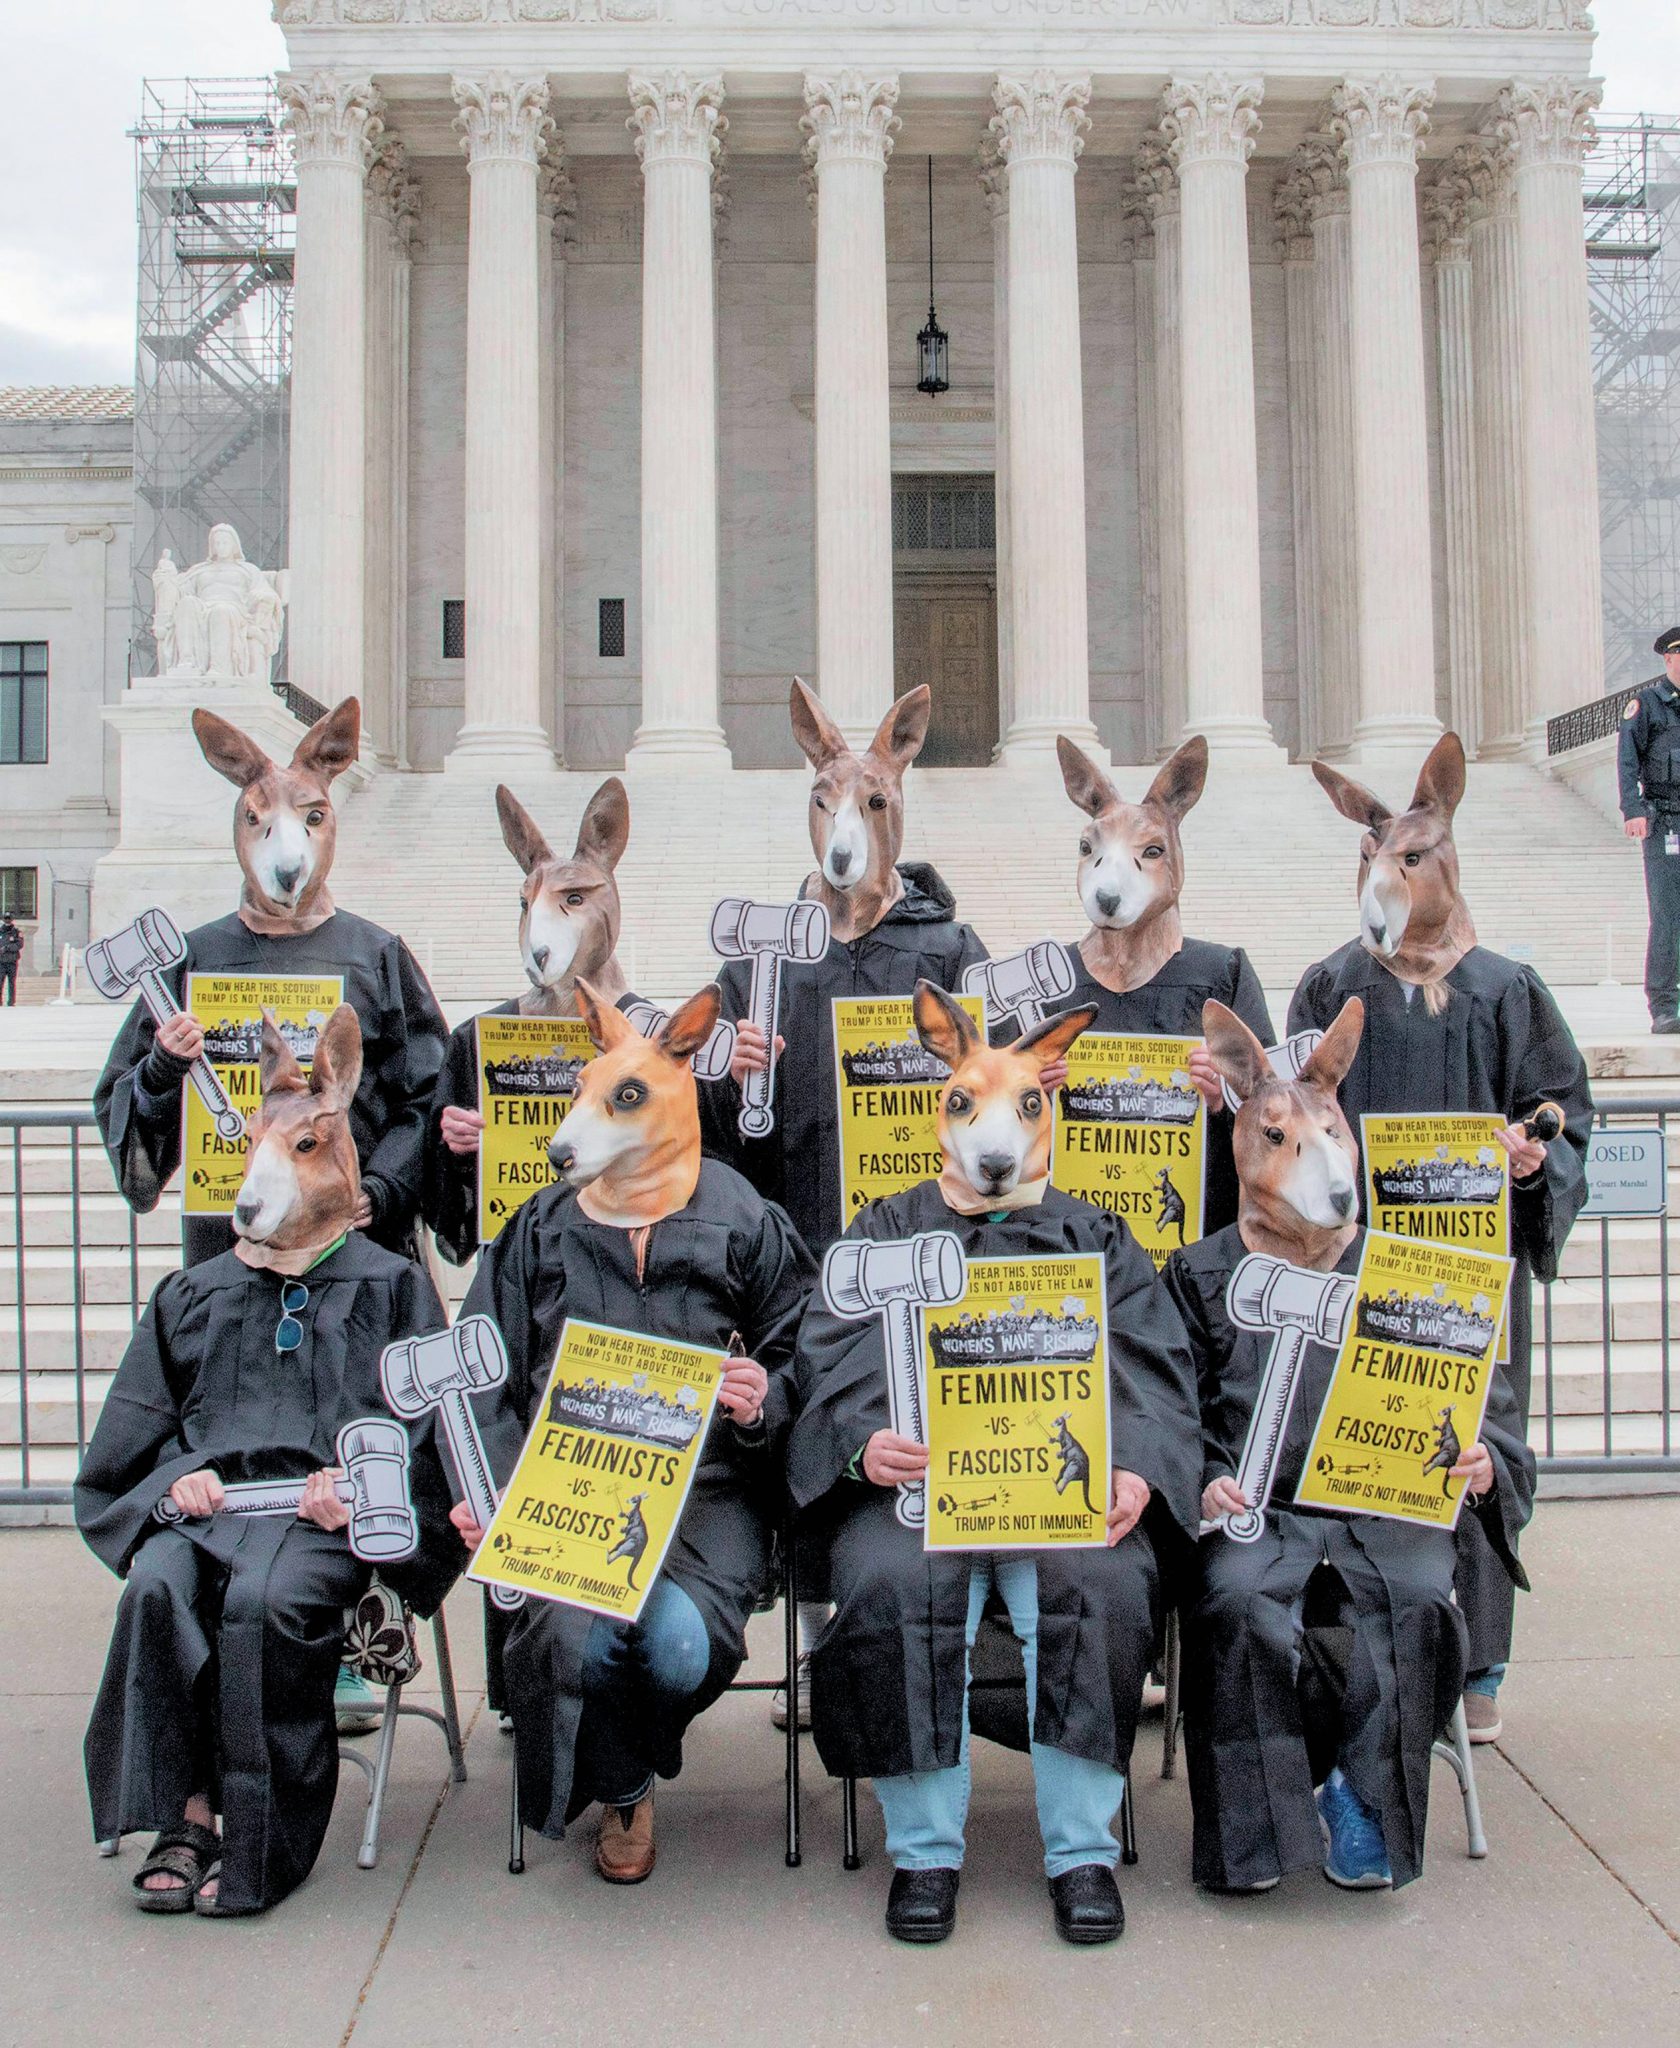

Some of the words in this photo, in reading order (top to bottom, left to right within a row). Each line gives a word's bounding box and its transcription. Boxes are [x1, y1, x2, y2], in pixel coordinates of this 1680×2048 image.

[213, 981, 232, 992] NOW
[234, 981, 256, 993] HEAR
[196, 993, 227, 1004] TRUMP
[229, 993, 238, 1004] IS
[242, 994, 259, 1004] NOT
[262, 994, 292, 1005] ABOVE
[295, 995, 315, 1006] THE
[318, 995, 335, 1006] LAW
[856, 1005, 875, 1015] NOW
[878, 1004, 899, 1014] HEAR
[500, 1021, 519, 1031] NOW
[522, 1022, 544, 1032] HEAR
[841, 1017, 870, 1027] TRUMP
[874, 1016, 882, 1026] IS
[886, 1016, 903, 1026] NOT
[485, 1031, 514, 1041] TRUMP
[518, 1032, 527, 1041] IS
[530, 1033, 548, 1042] NOT
[551, 1034, 583, 1043] ABOVE
[1080, 1040, 1098, 1051] NOW
[1100, 1040, 1122, 1051] HEAR
[852, 1061, 896, 1075] WOMEN'S
[902, 1059, 929, 1074] WAVE
[1067, 1051, 1092, 1062] RUMP
[1096, 1052, 1104, 1062] IS
[1108, 1053, 1124, 1063] NOT
[1128, 1054, 1156, 1064] ABOVE
[1161, 1055, 1177, 1065] THE
[494, 1072, 540, 1086] WOMEN'S
[545, 1072, 574, 1086] WAVE
[852, 1089, 942, 1116] FEMINI
[1069, 1096, 1113, 1112] WOMEN'S
[1119, 1097, 1147, 1112] WAVE
[494, 1100, 575, 1126] FEMIN
[888, 1126, 916, 1142] -VS-
[1385, 1121, 1403, 1132] NOW
[1405, 1120, 1426, 1131] HEAR
[529, 1135, 552, 1151] -VS
[1066, 1126, 1191, 1157] FEMINISTS
[1371, 1134, 1399, 1144] TRUMP
[1403, 1133, 1411, 1143] IS
[1414, 1133, 1430, 1143] NOT
[1434, 1132, 1461, 1142] ABOVE
[1466, 1132, 1482, 1142] THE
[1484, 1131, 1499, 1141] LA
[859, 1152, 944, 1175] FASCISTS
[1587, 1146, 1645, 1163] OSED
[498, 1162, 562, 1184] FASCI
[1099, 1164, 1127, 1180] -VS-
[1382, 1180, 1425, 1195] WOMEN'S
[1429, 1178, 1456, 1194] WAVE
[1069, 1188, 1152, 1214] ASCISTS
[1382, 1210, 1496, 1238] FEMINISTS
[1389, 1244, 1408, 1257] NOW
[1410, 1248, 1432, 1262] HEAR
[1456, 1257, 1491, 1274] SCOTUS!!
[974, 1266, 1000, 1279] HEAR
[1004, 1266, 1028, 1279] THIS,
[1032, 1264, 1076, 1277] SCOTUS!!
[1370, 1254, 1400, 1270] TRUMP
[1403, 1261, 1412, 1273] IS
[1415, 1263, 1432, 1276] NOT
[1435, 1268, 1463, 1283] ABOVE
[1466, 1273, 1482, 1287] THE
[1484, 1277, 1502, 1290] LAW
[970, 1282, 979, 1293] IS
[984, 1281, 1003, 1292] NOT
[1008, 1280, 1042, 1292] ABOVE
[1047, 1279, 1066, 1290] THE
[1072, 1278, 1093, 1289] LAW
[1366, 1310, 1411, 1333] WOMEN'S
[1416, 1318, 1445, 1336] WAVE
[588, 1333, 607, 1347] NOW
[611, 1337, 633, 1352] HEAR
[660, 1349, 702, 1368] SCOTUS!!
[941, 1337, 995, 1353] WOMEN'S
[1002, 1334, 1035, 1352] WAVE
[568, 1343, 599, 1359] TRUMP
[602, 1350, 612, 1362] IS
[615, 1353, 633, 1366] NOT
[636, 1358, 668, 1374] ABOVE
[671, 1365, 689, 1379] THE
[692, 1370, 714, 1384] LAW
[1351, 1344, 1479, 1395] FEMINISTS
[941, 1369, 1091, 1405] FEMINISTS
[560, 1396, 606, 1421] WOMEN'S
[611, 1406, 643, 1426] WAVE
[1380, 1393, 1409, 1413] -VS-
[984, 1416, 1016, 1435] -VS-
[1335, 1416, 1429, 1455] FASCISTS
[539, 1429, 680, 1487] FEMINISTS
[948, 1447, 1049, 1476] FASCISTS
[567, 1478, 596, 1498] -VS-
[1326, 1478, 1362, 1496] TRUMP
[1362, 1484, 1374, 1497] IS
[1374, 1485, 1398, 1502] NOT
[1397, 1490, 1446, 1511] IMMUNE!
[517, 1497, 614, 1541] FASCISTS
[955, 1516, 995, 1531] TRUMP
[999, 1515, 1010, 1530] IS
[1013, 1515, 1036, 1530] NOT
[1040, 1514, 1093, 1530] IMMUNE!
[501, 1555, 540, 1576] TRUMP
[540, 1566, 553, 1581] IS
[552, 1570, 578, 1587] NOT
[577, 1576, 629, 1601] IMMUNE!
